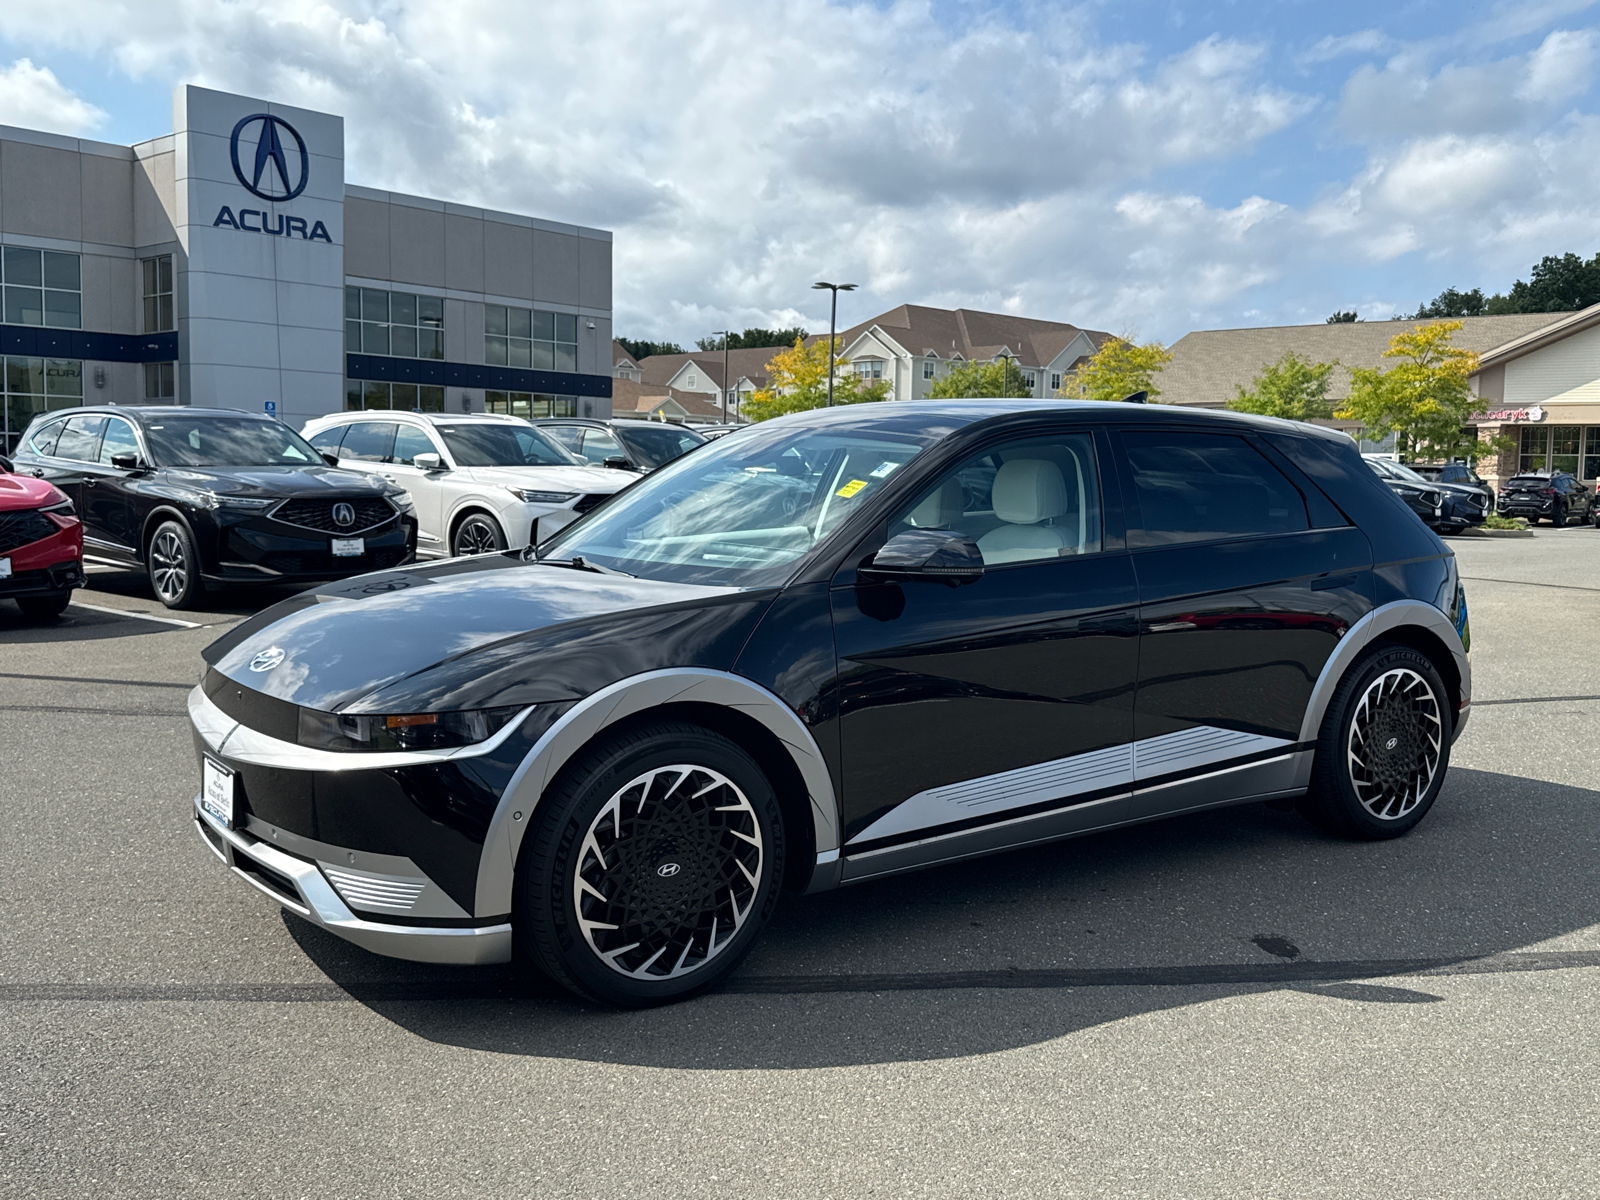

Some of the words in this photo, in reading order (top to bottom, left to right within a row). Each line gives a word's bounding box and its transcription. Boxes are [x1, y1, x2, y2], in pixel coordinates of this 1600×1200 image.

[213, 205, 333, 243] ACURA
[1388, 652, 1430, 670] MICHELIN
[579, 786, 598, 812] 255/45
[604, 772, 612, 783] 20
[552, 822, 577, 926] MICHELIN
[763, 824, 783, 914] MICHELIN
